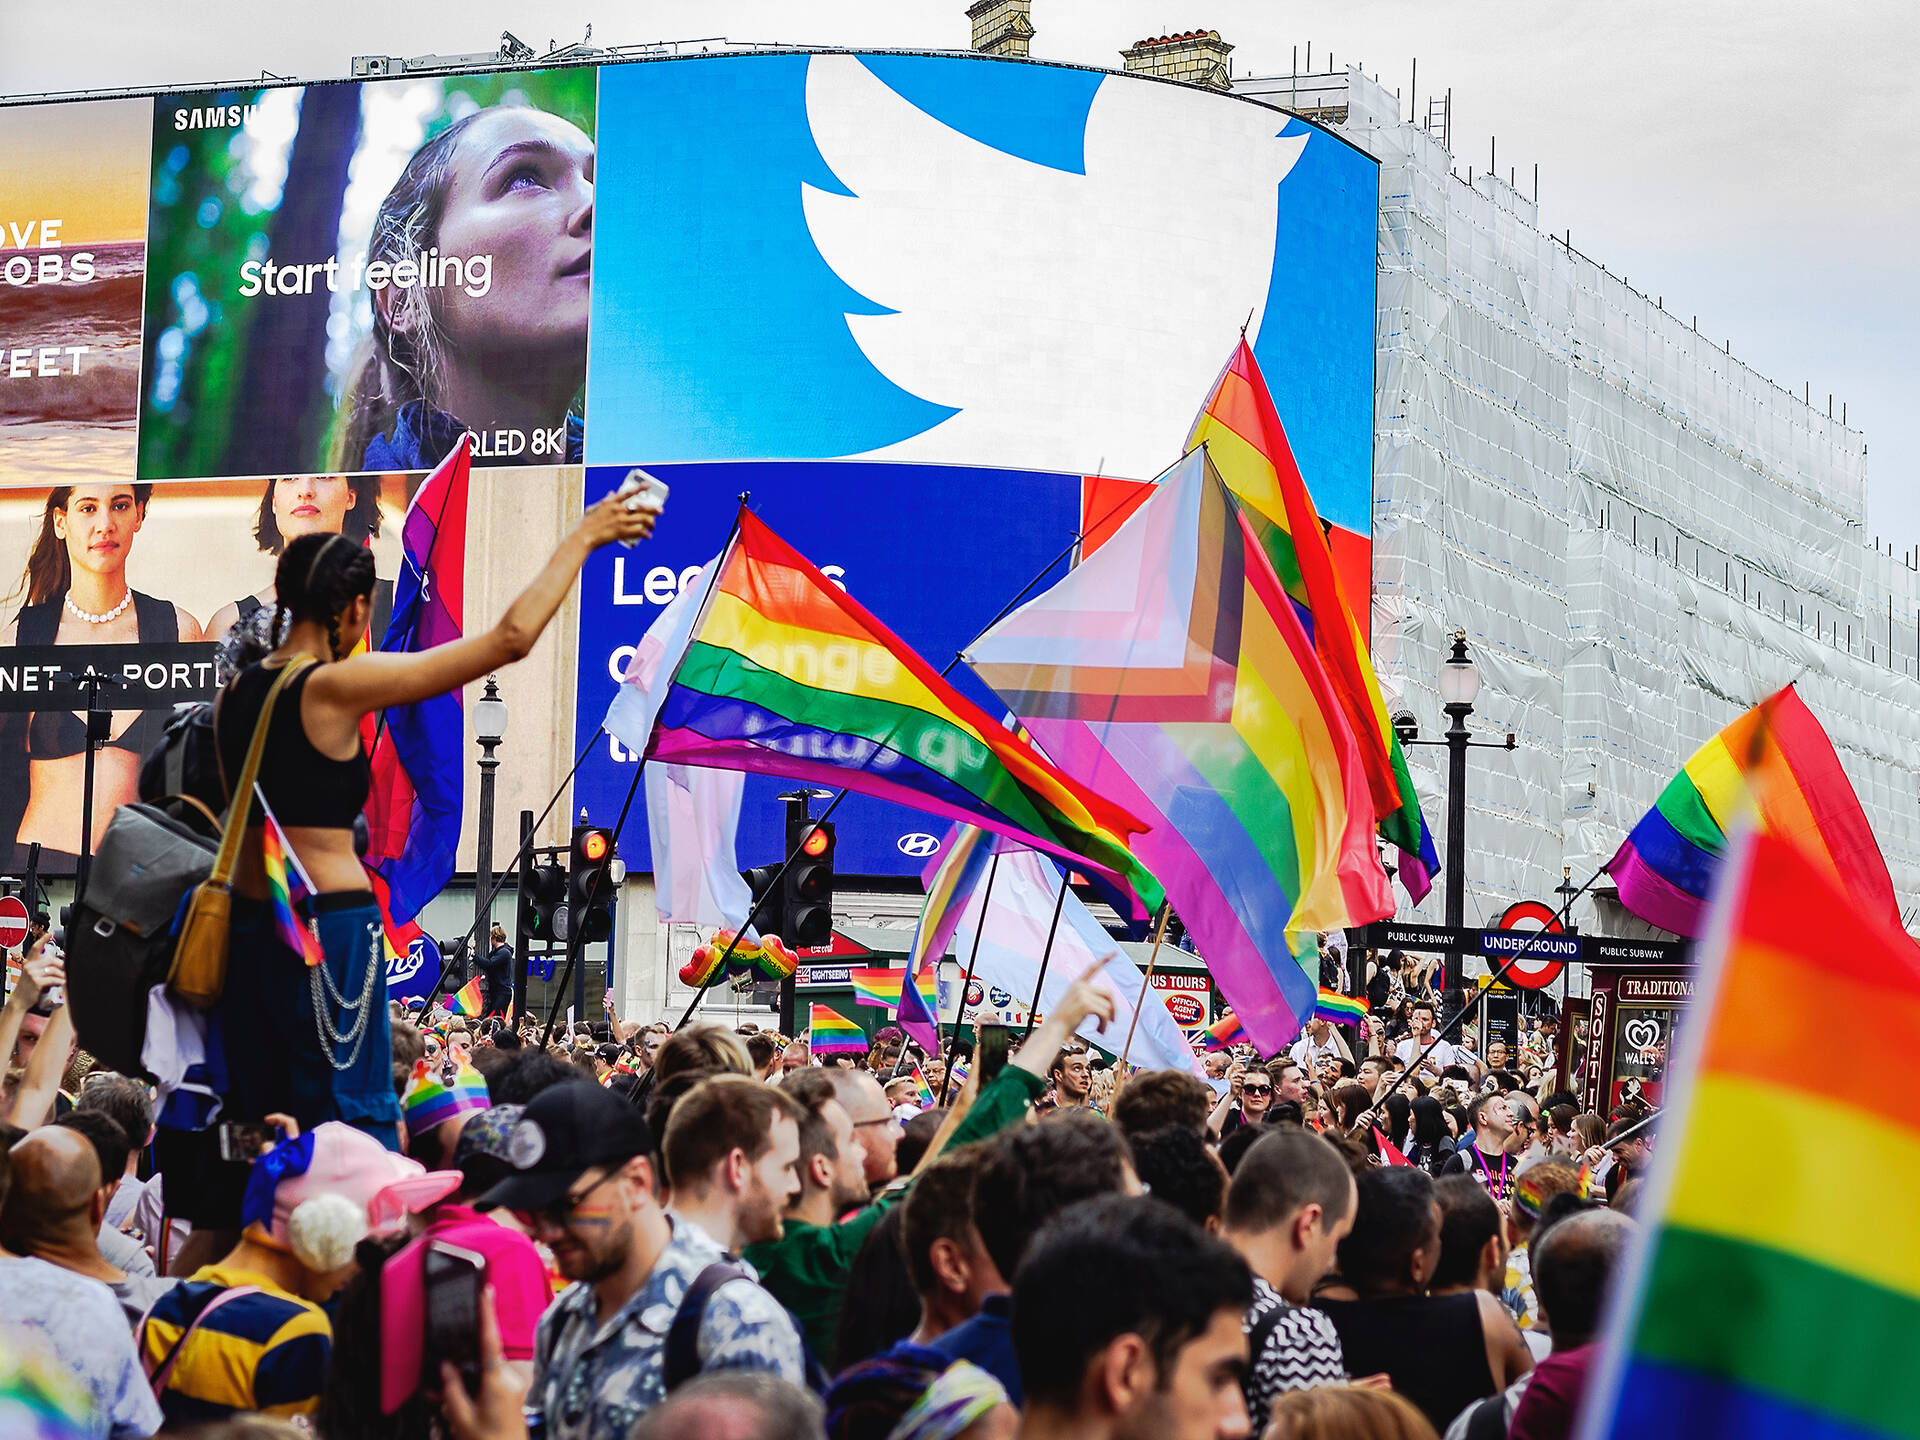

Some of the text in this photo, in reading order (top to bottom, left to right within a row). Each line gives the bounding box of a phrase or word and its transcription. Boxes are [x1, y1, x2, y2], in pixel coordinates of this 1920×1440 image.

[4, 252, 96, 287] OBS
[238, 246, 493, 299] Start feeling
[456, 427, 565, 457] QLED 8K
[0, 665, 62, 692] NET
[1387, 931, 1455, 945] PUBLIC SUBWAY
[1484, 936, 1577, 955] UNDERGROUND
[1600, 945, 1664, 959] PUBLIC SUBWAY
[811, 968, 849, 981] SIGHTSEEING
[1149, 975, 1206, 989] US TOURS
[1171, 996, 1200, 1009] OFFICIAL
[1172, 1004, 1197, 1015] AGENT
[1589, 997, 1603, 1079] SOFT
